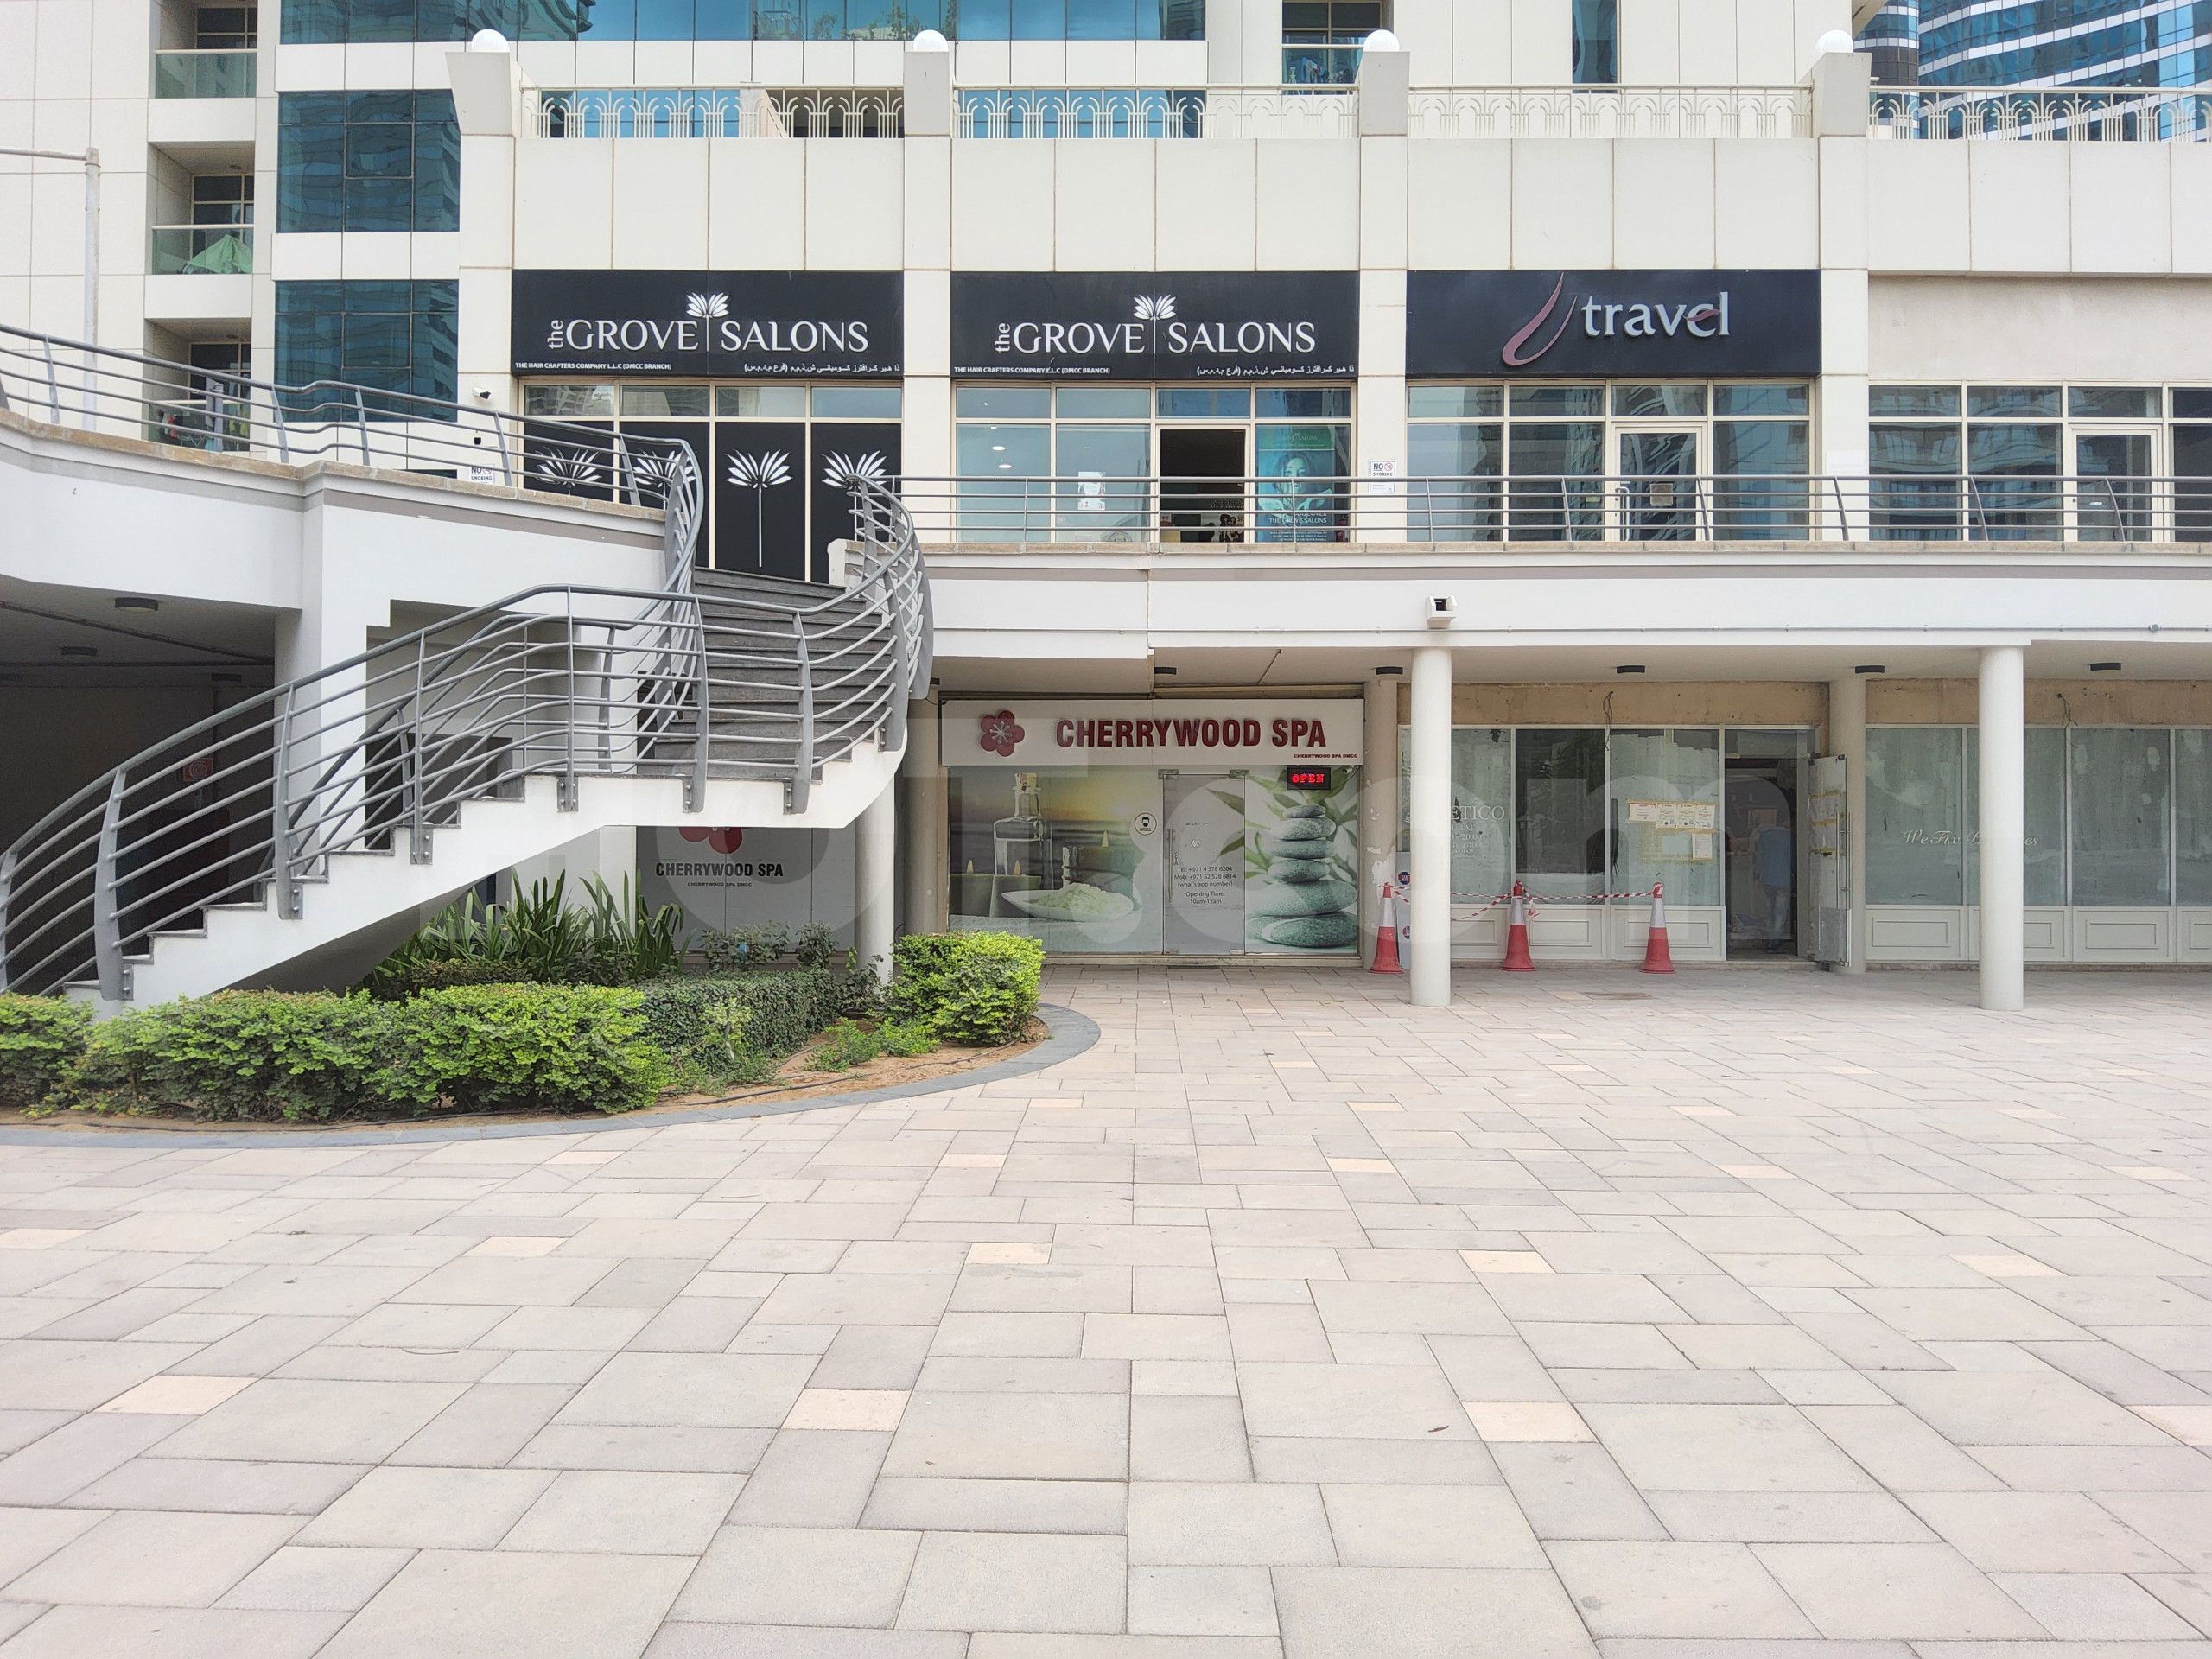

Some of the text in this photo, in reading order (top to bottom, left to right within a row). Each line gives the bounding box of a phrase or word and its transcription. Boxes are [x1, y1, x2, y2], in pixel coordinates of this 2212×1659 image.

[1580, 291, 1730, 338] travel
[546, 319, 869, 353] the GROVE SALONS
[994, 321, 1316, 354] the GROVE SALONS
[644, 363, 672, 372] BRANCH)
[1056, 719, 1327, 748] CHERRYWOOD SPA
[1291, 772, 1325, 784] OPEN
[1451, 805, 1505, 821] ETICO
[655, 862, 784, 878] CHERRYWOOD SPA
